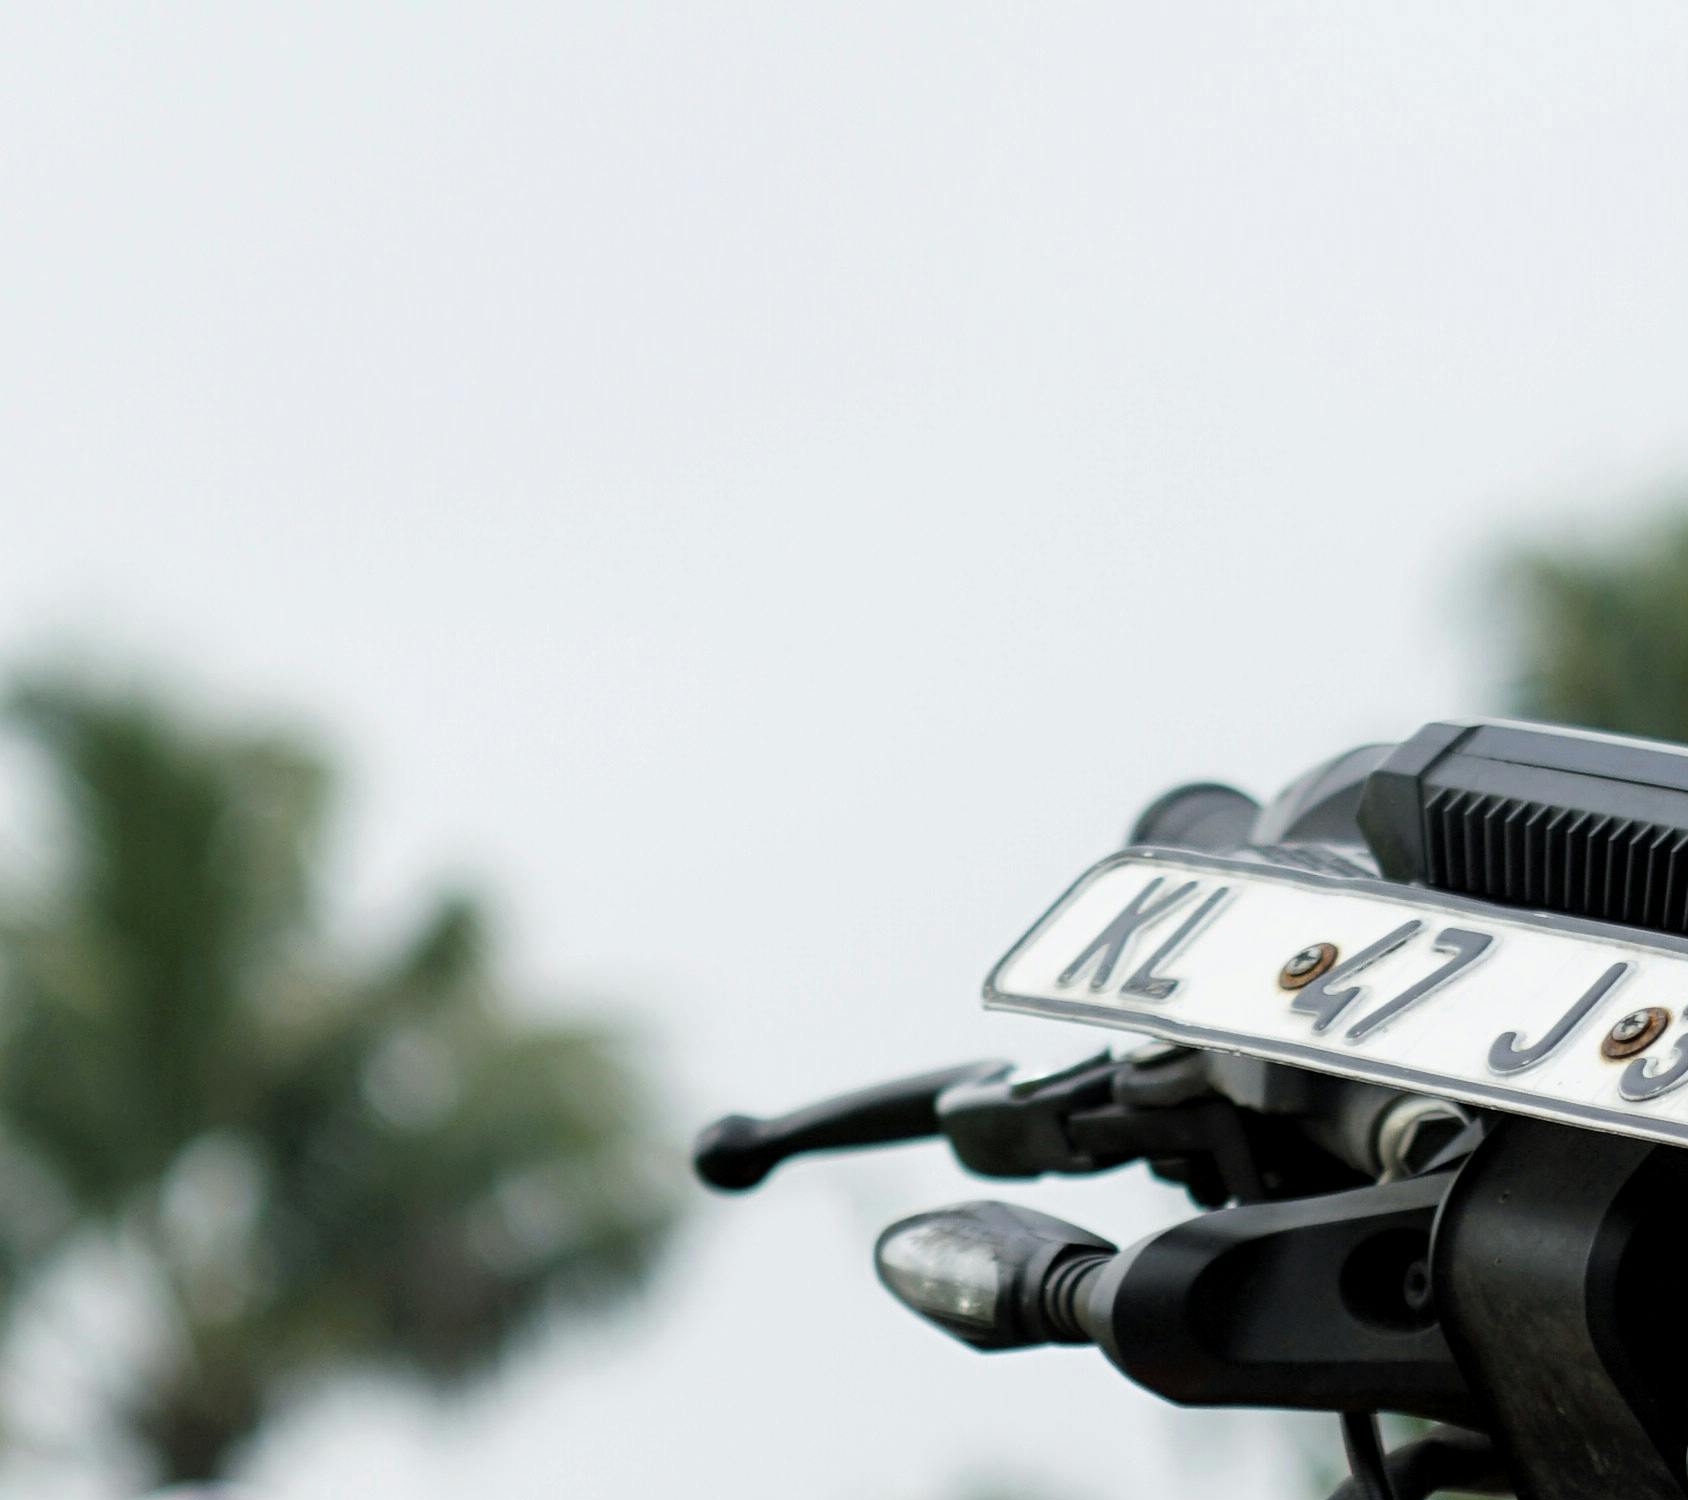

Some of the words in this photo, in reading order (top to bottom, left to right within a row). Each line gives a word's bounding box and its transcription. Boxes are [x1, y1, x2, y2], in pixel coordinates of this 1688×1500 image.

[1056, 876, 1233, 1000] KL
[1289, 918, 1494, 1043] 47
[1487, 960, 1630, 1075] J
